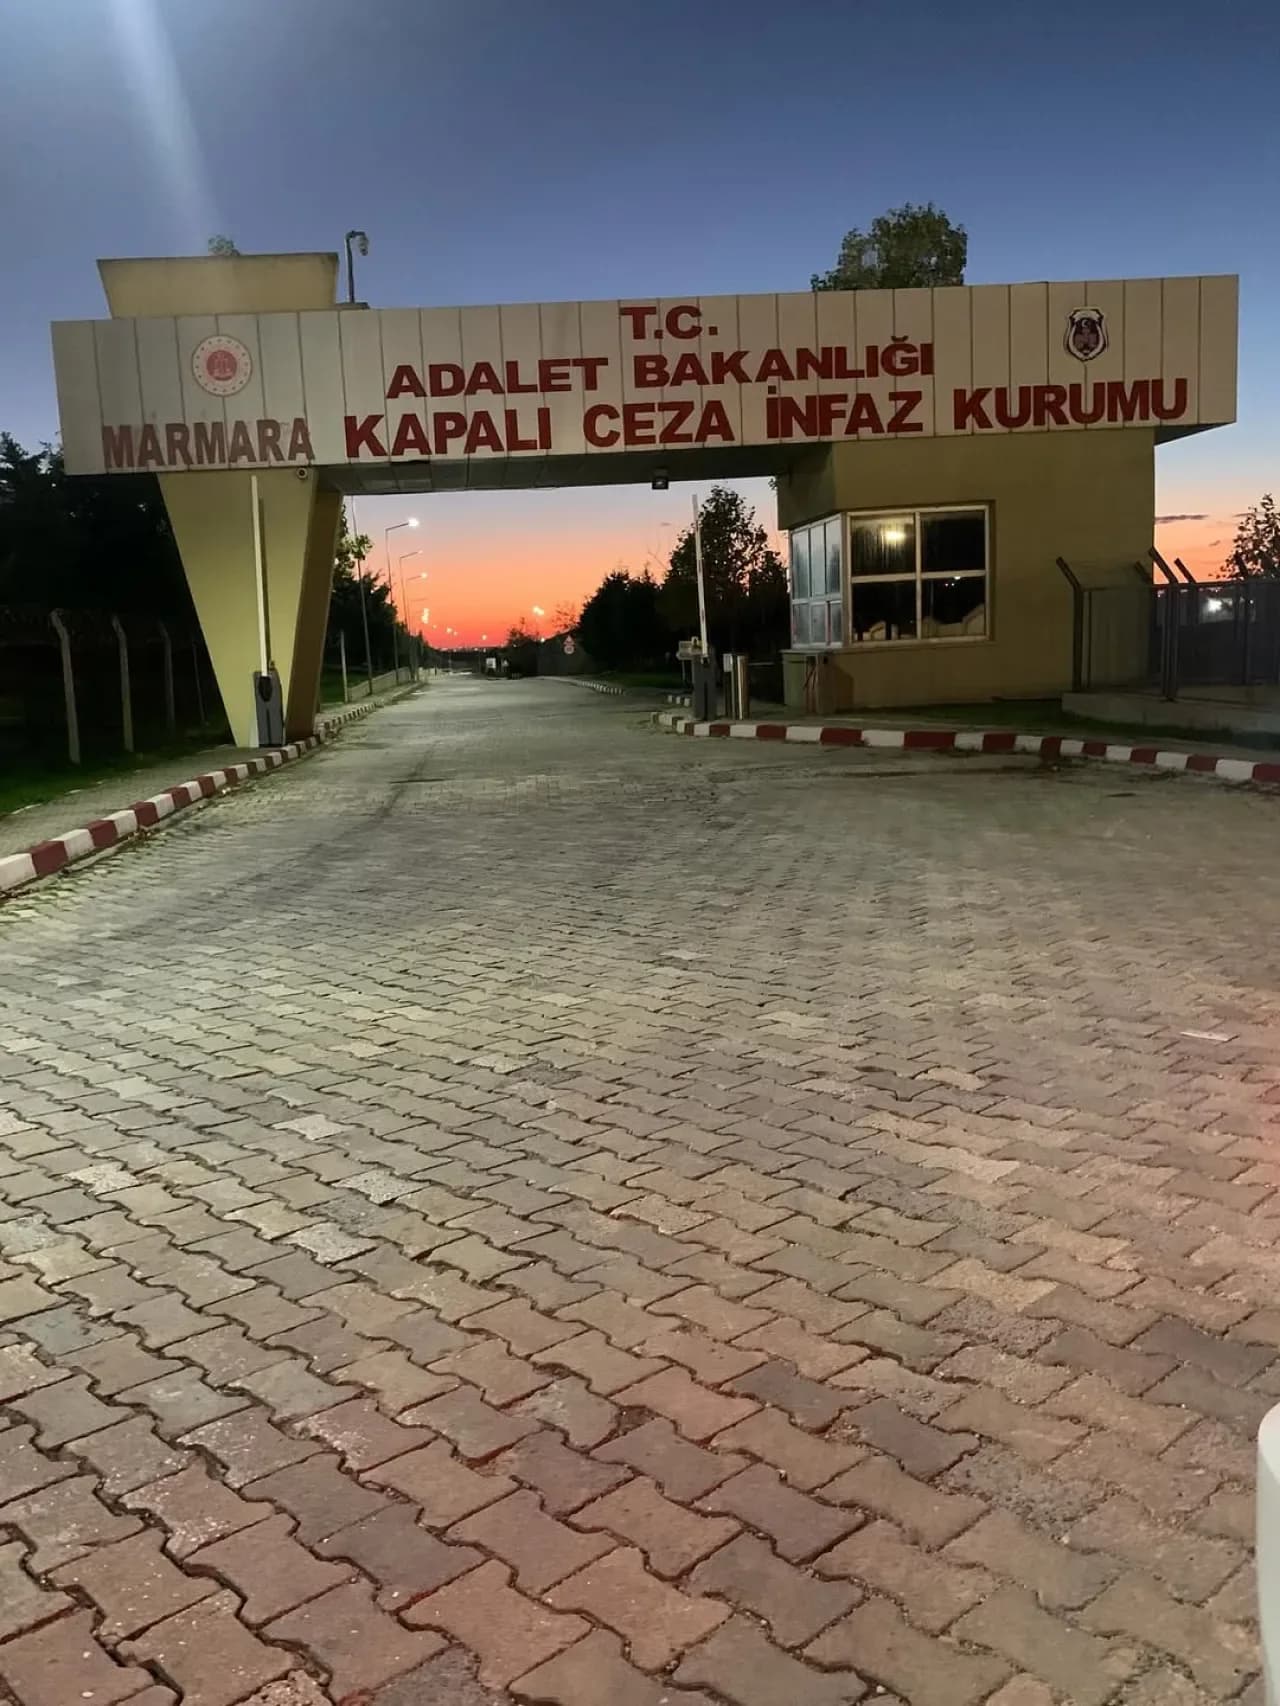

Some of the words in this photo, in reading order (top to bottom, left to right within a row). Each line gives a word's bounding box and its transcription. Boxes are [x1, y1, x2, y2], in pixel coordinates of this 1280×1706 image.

[619, 305, 719, 339] T.C.
[387, 357, 608, 399] ADALET
[633, 335, 934, 388] BAKANLIĞI
[102, 417, 315, 468] MARMARA
[344, 406, 552, 457] KAPALI
[583, 400, 735, 449] CEZA
[766, 385, 924, 439] İNFAZ
[953, 378, 1188, 430] KURUMU
